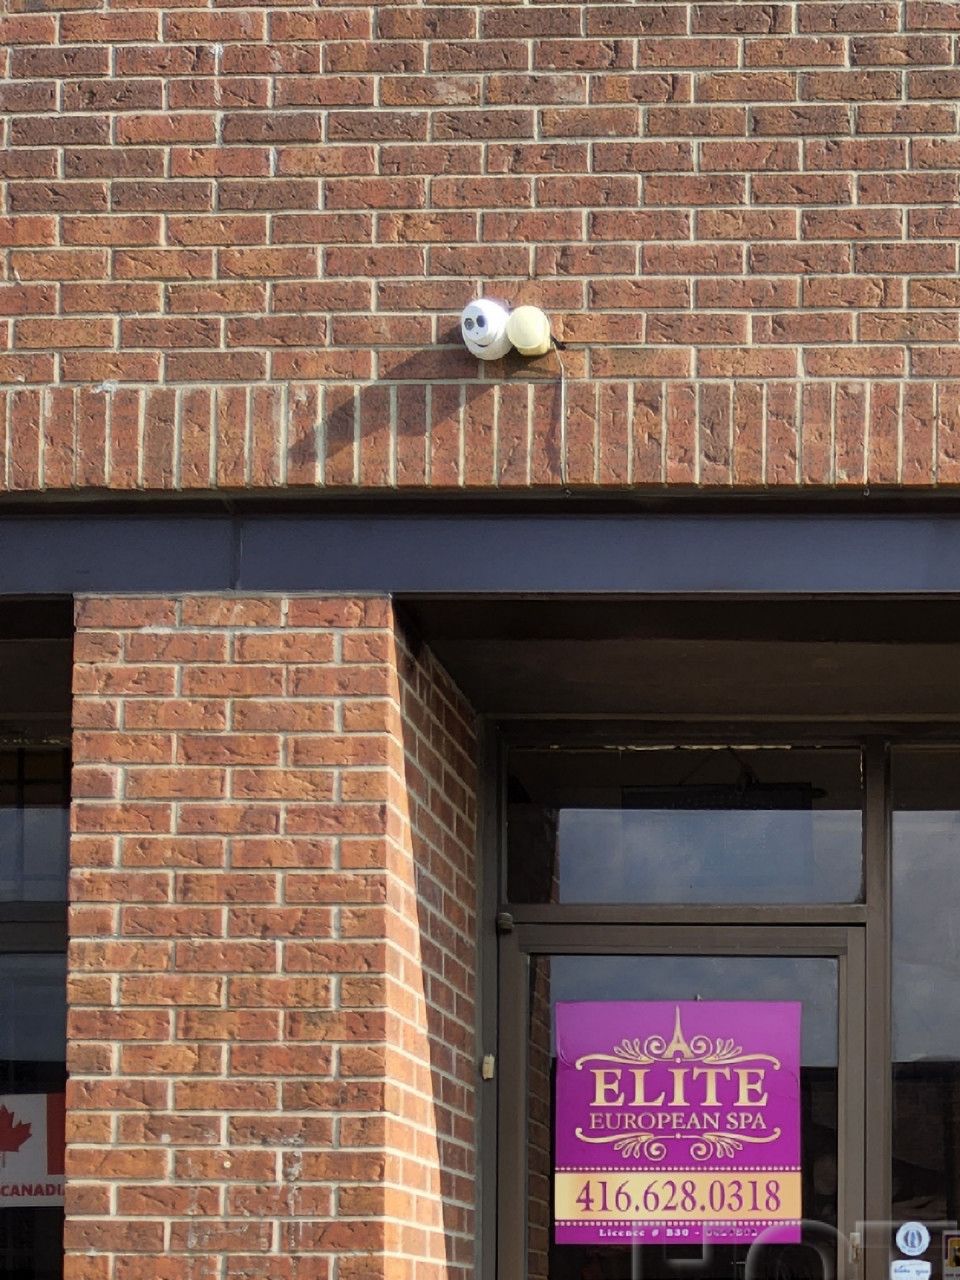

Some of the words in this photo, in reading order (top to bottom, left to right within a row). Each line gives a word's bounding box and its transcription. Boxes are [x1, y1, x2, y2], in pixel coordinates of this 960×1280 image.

[590, 1067, 768, 1107] ELITE
[589, 1112, 720, 1130] EUROPEAN
[726, 1112, 767, 1130] SPA
[1, 1183, 65, 1197] CANADI
[575, 1179, 782, 1212] 416.628.0318
